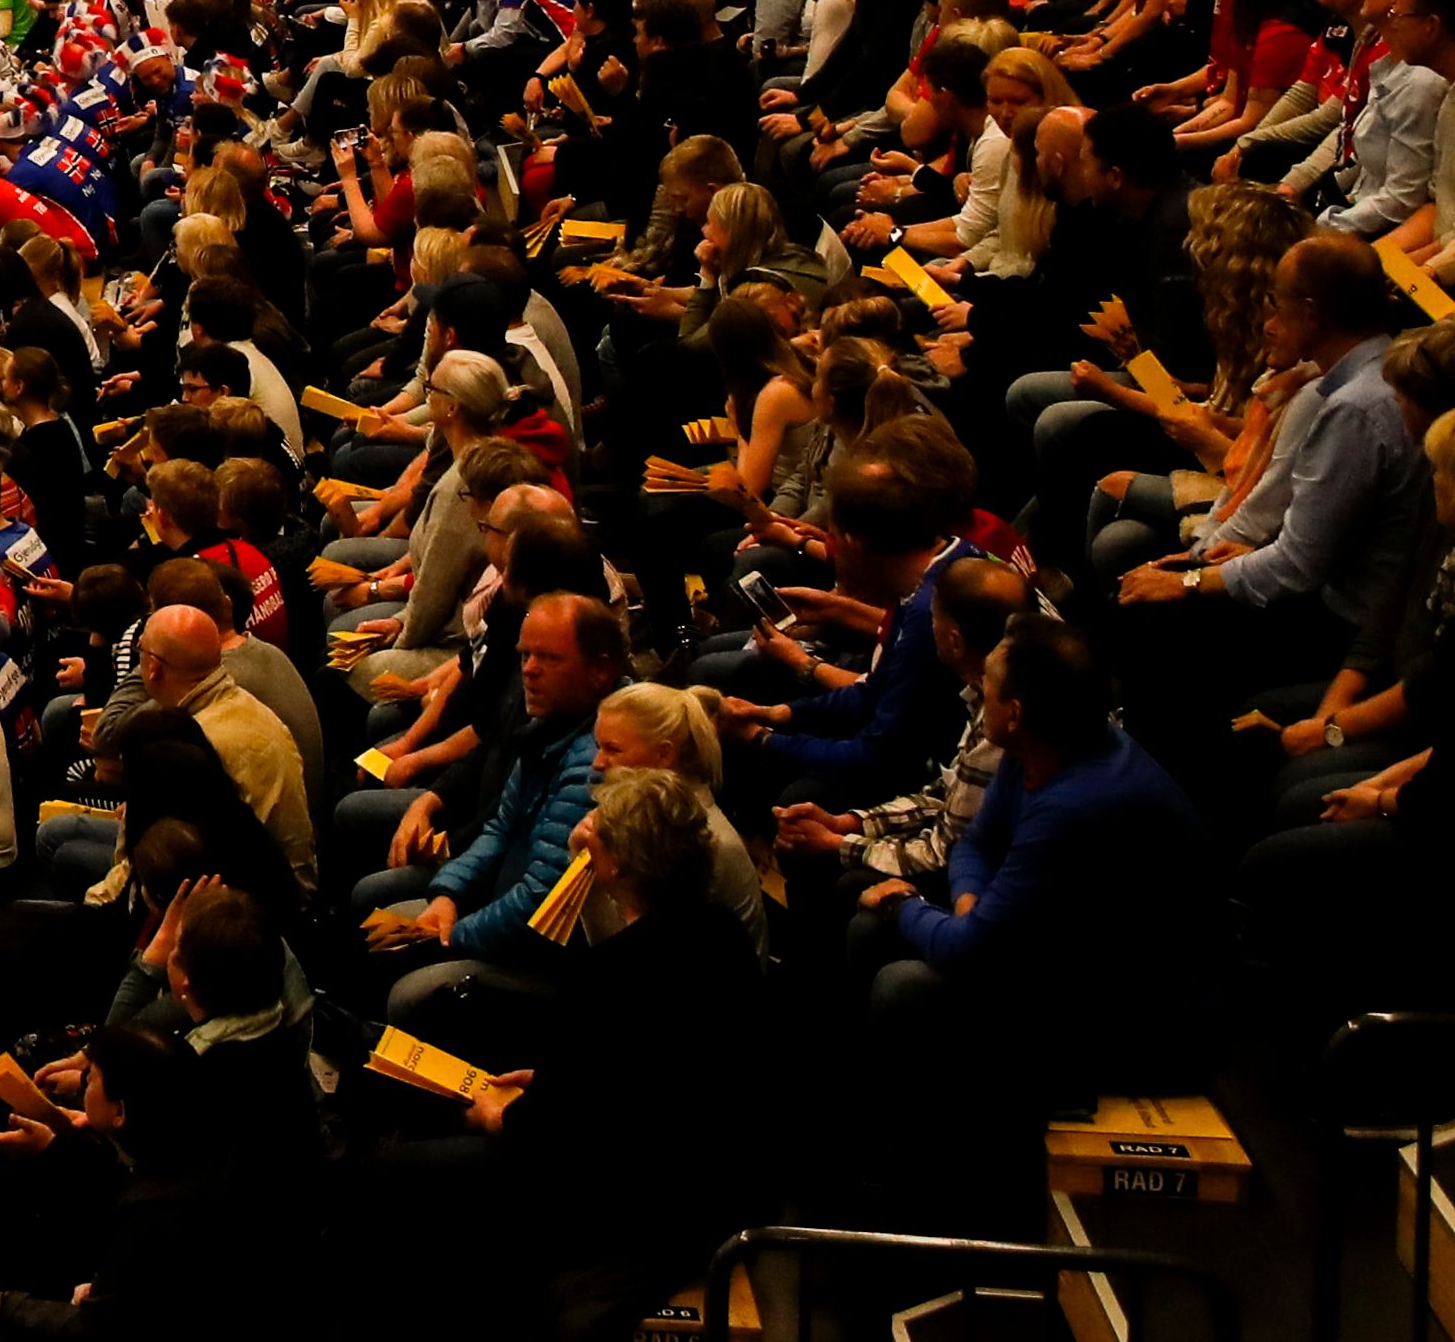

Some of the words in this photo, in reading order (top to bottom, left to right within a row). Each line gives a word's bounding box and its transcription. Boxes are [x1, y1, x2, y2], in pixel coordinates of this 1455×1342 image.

[1119, 1144, 1162, 1154] RAD
[1168, 1146, 1178, 1155] 7
[1114, 1169, 1164, 1192] RAD
[1175, 1172, 1187, 1193] 7
